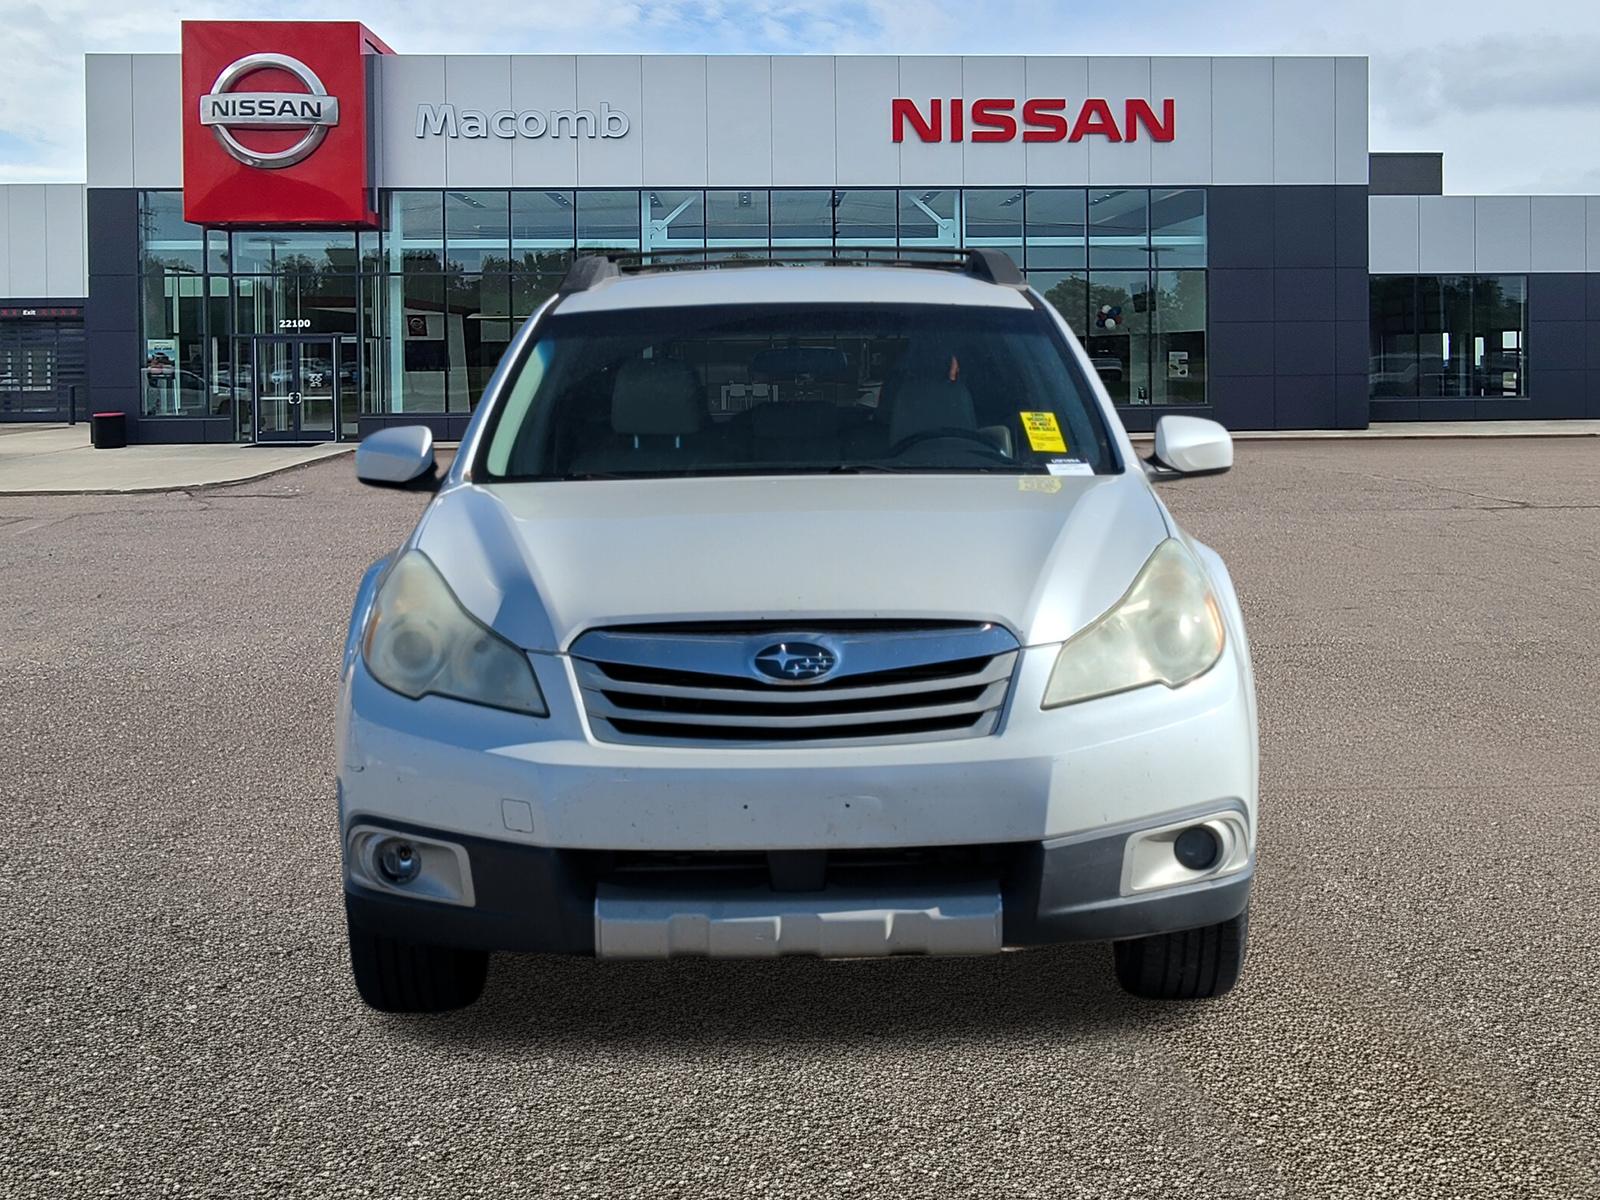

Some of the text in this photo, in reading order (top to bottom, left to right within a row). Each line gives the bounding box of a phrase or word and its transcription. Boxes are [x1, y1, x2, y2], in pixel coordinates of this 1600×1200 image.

[212, 100, 322, 117] NISSAN
[415, 101, 630, 139] Macomb
[891, 98, 1176, 143] NISSAN
[279, 319, 311, 328] 22100
